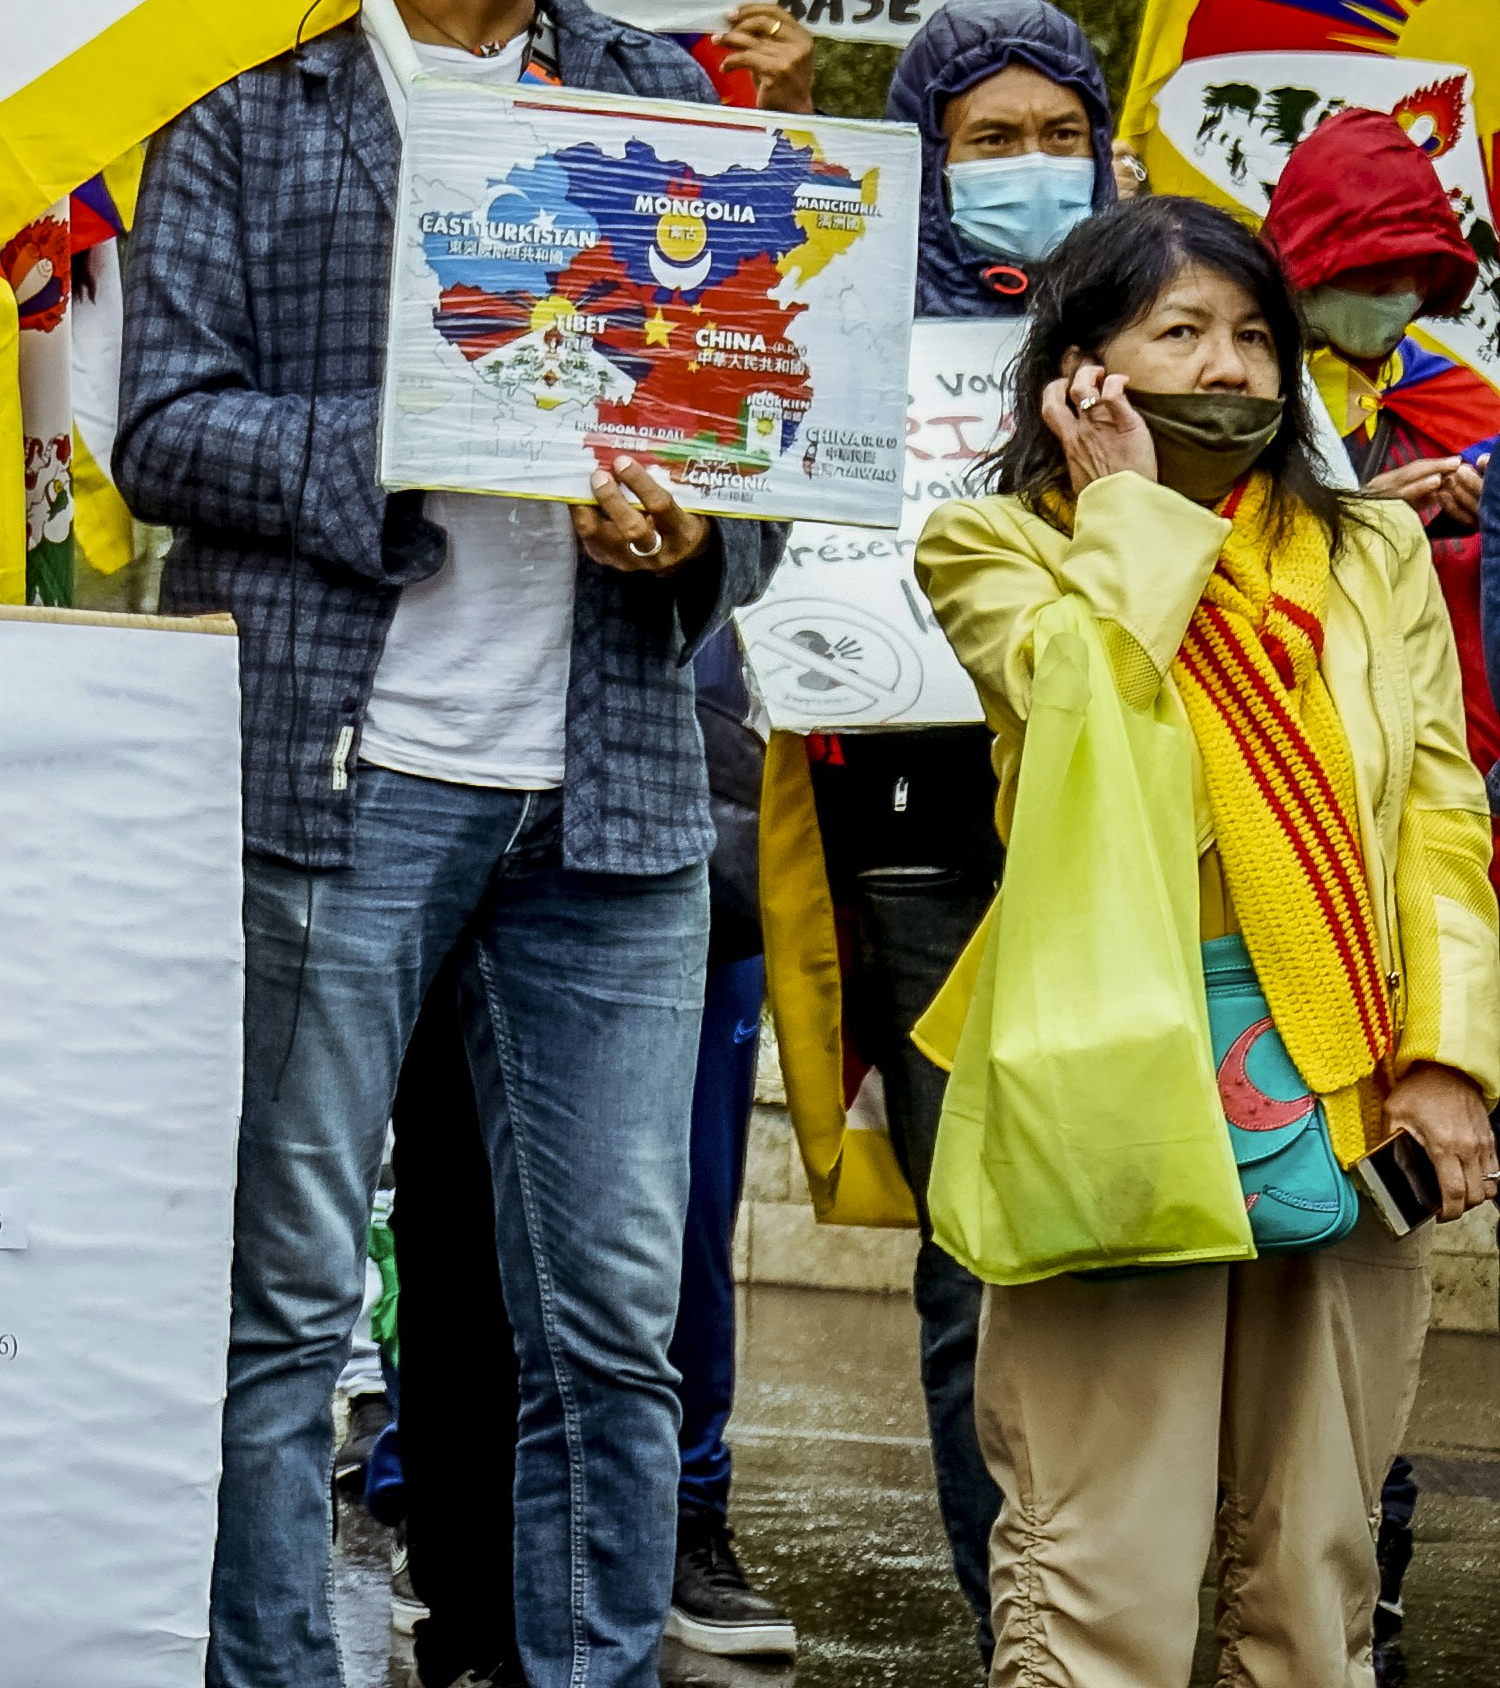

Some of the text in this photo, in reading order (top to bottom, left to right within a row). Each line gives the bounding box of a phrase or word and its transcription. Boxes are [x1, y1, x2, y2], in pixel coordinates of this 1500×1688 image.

[635, 194, 756, 224] MONGOLIA
[421, 214, 597, 248] EAST TURKISTAN
[555, 314, 609, 334] TIBET
[695, 328, 767, 353] CHINA
[688, 470, 772, 493] CANTONIA
